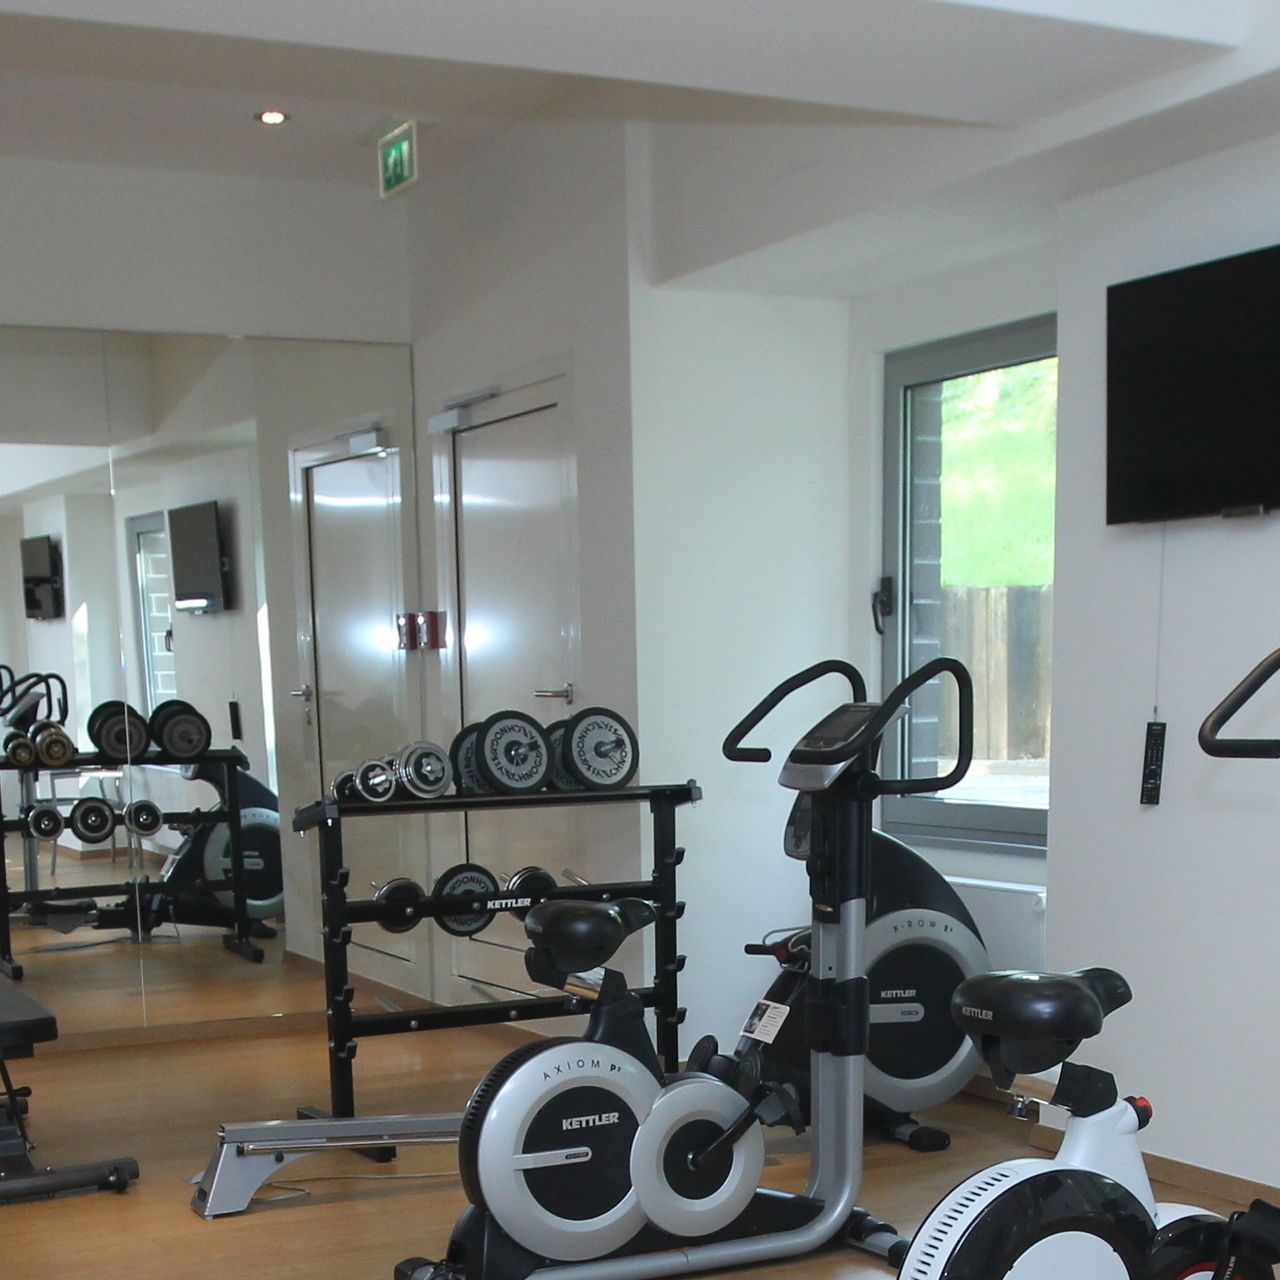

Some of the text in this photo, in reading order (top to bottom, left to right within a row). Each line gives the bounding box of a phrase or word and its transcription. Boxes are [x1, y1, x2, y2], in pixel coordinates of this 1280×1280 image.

[487, 898, 531, 909] KETTLER
[881, 989, 916, 998] KETTLER
[962, 1006, 993, 1020] KETTLER
[543, 1059, 600, 1080] AXIOM
[562, 1112, 620, 1130] KETTLER
